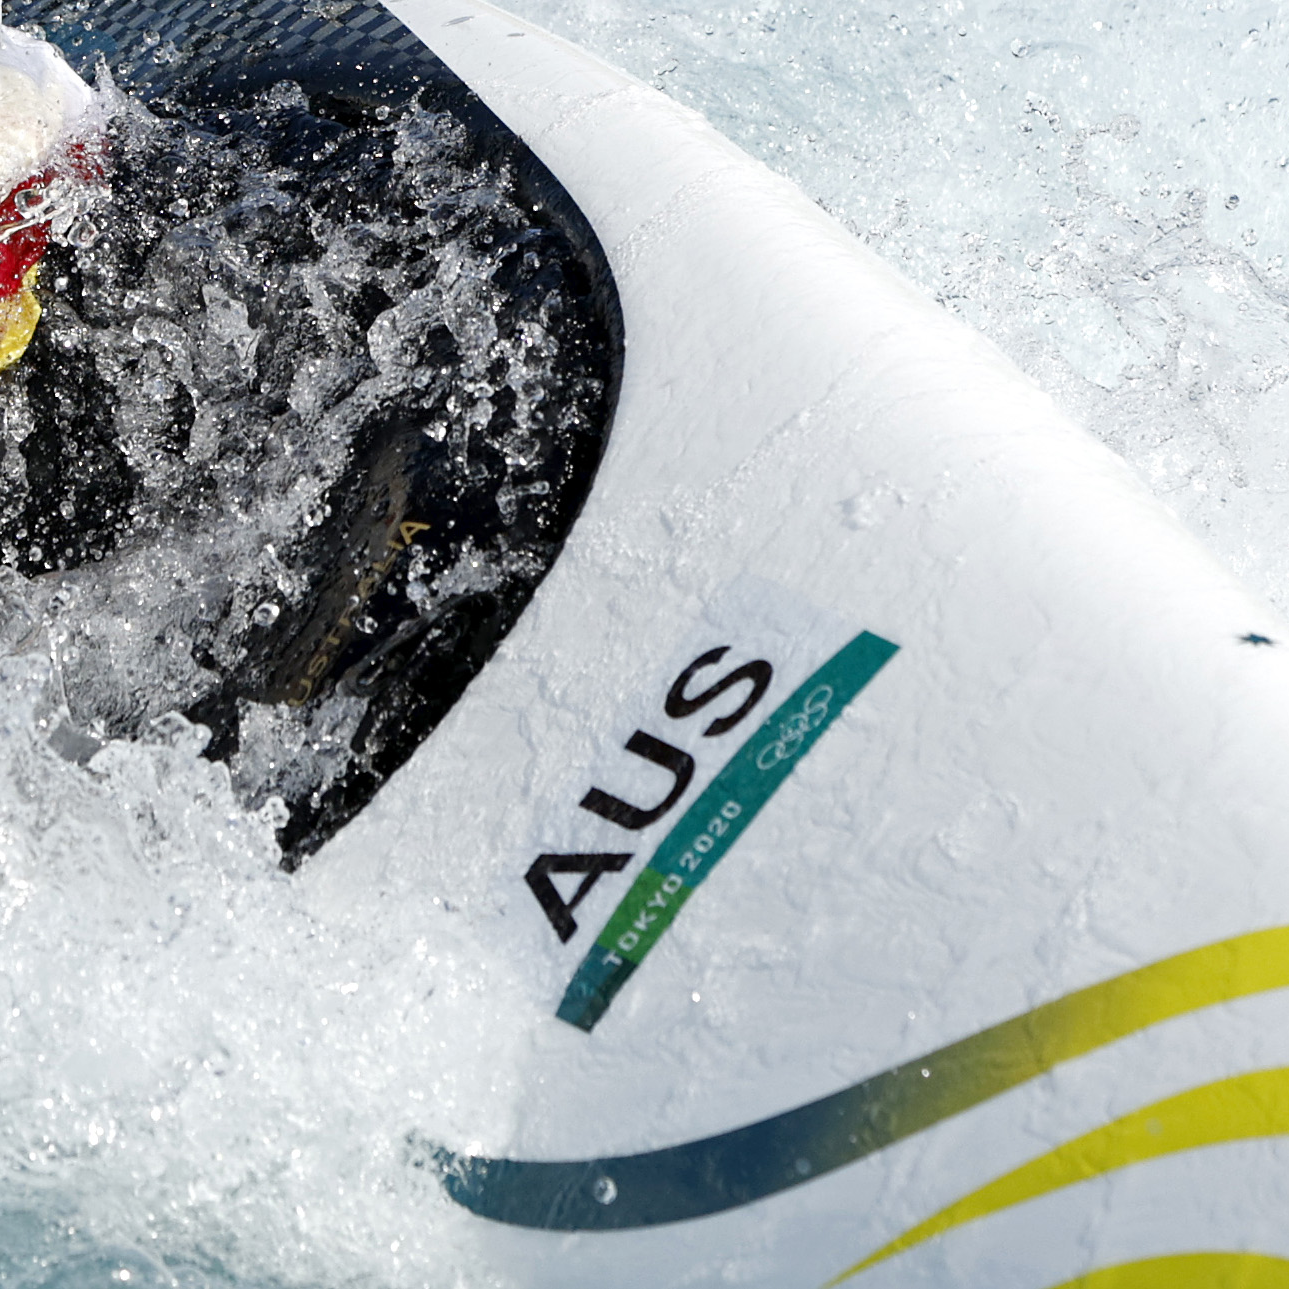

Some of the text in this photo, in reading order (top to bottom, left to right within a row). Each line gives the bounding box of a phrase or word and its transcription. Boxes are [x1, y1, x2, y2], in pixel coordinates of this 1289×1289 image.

[524, 646, 773, 944] AUS
[602, 801, 742, 968] TOKYO 2020
